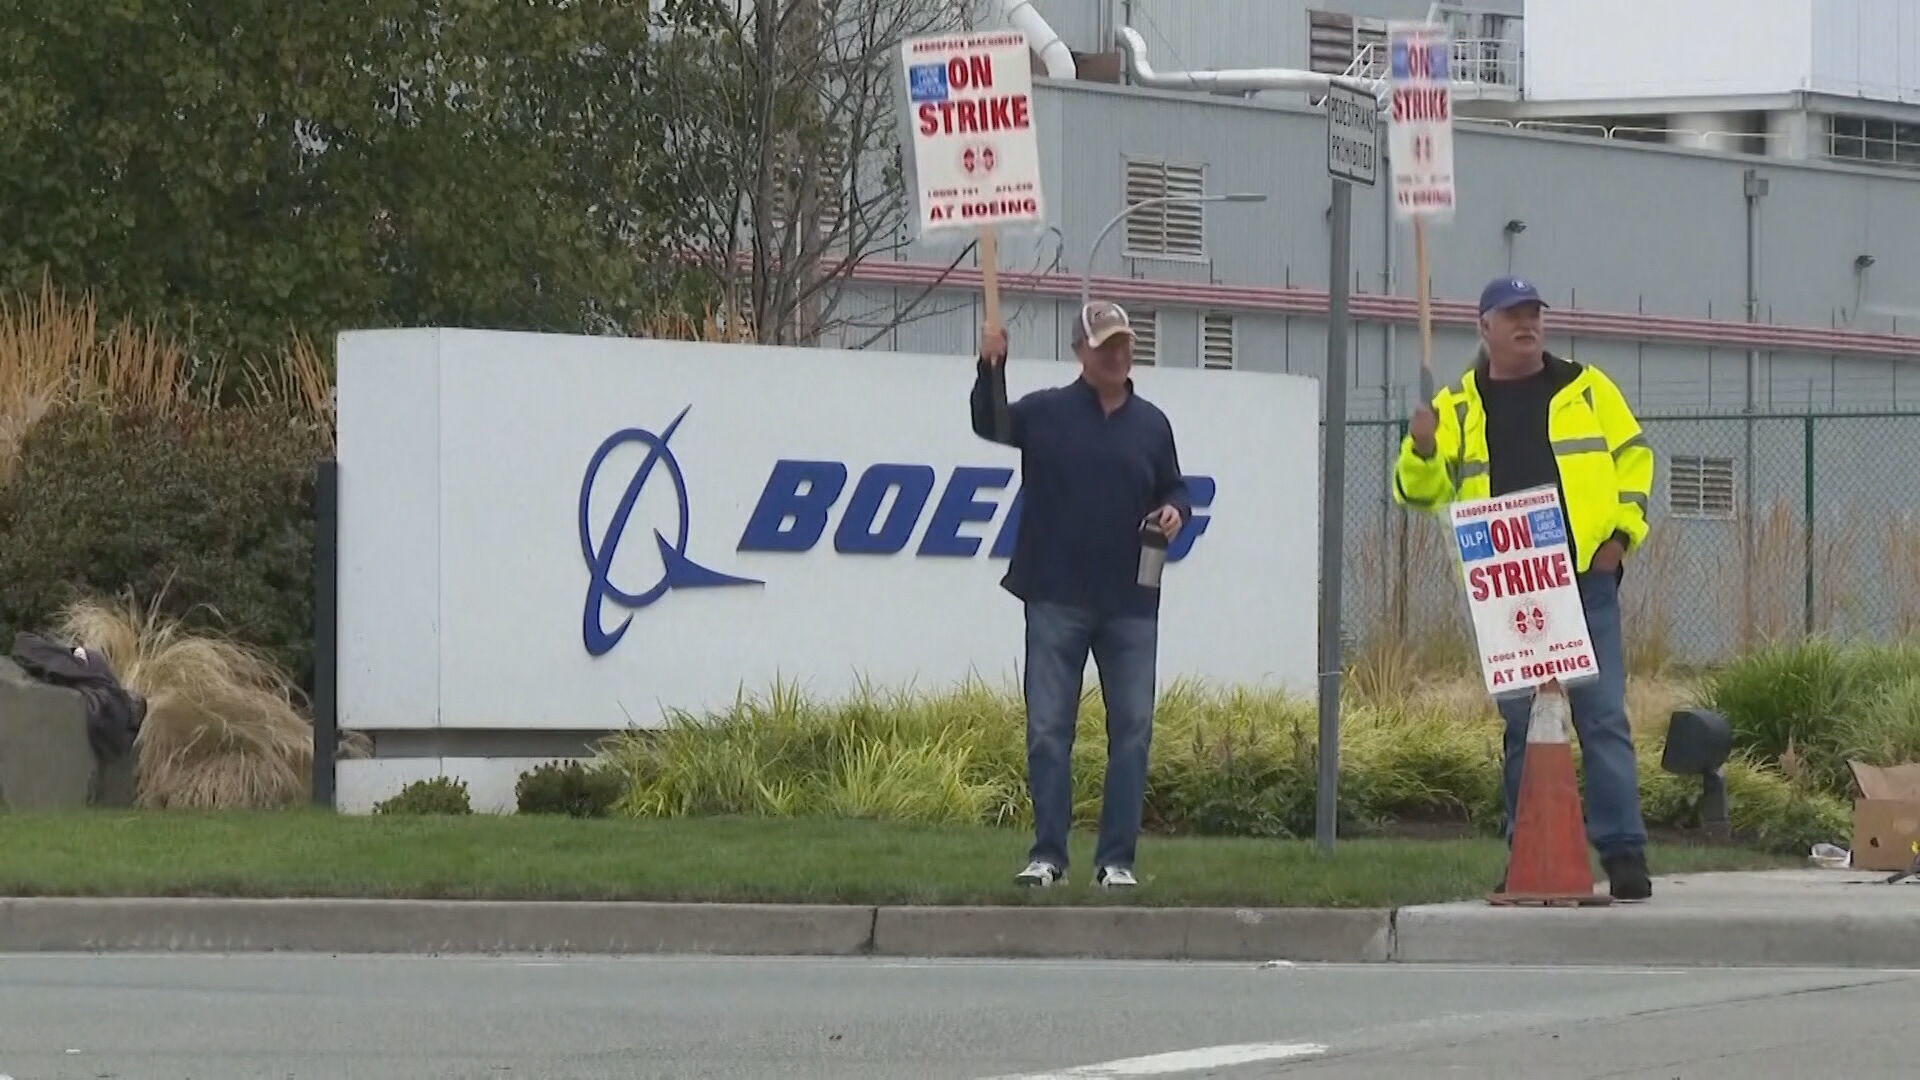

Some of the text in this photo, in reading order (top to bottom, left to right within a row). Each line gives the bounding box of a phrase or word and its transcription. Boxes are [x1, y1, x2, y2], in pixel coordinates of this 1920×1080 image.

[949, 54, 993, 89] ON
[1408, 44, 1430, 78] ON
[919, 96, 1029, 135] STRIKE
[1393, 87, 1448, 122] STRIKE
[930, 198, 1036, 220] AT BOEING
[1456, 493, 1555, 518] AEROSPACE MACHINISTS
[1491, 514, 1533, 553] ON
[1470, 553, 1571, 602] STRIKE
[1549, 639, 1584, 652] AFL-CIO
[1493, 655, 1591, 686] AT BOEING
